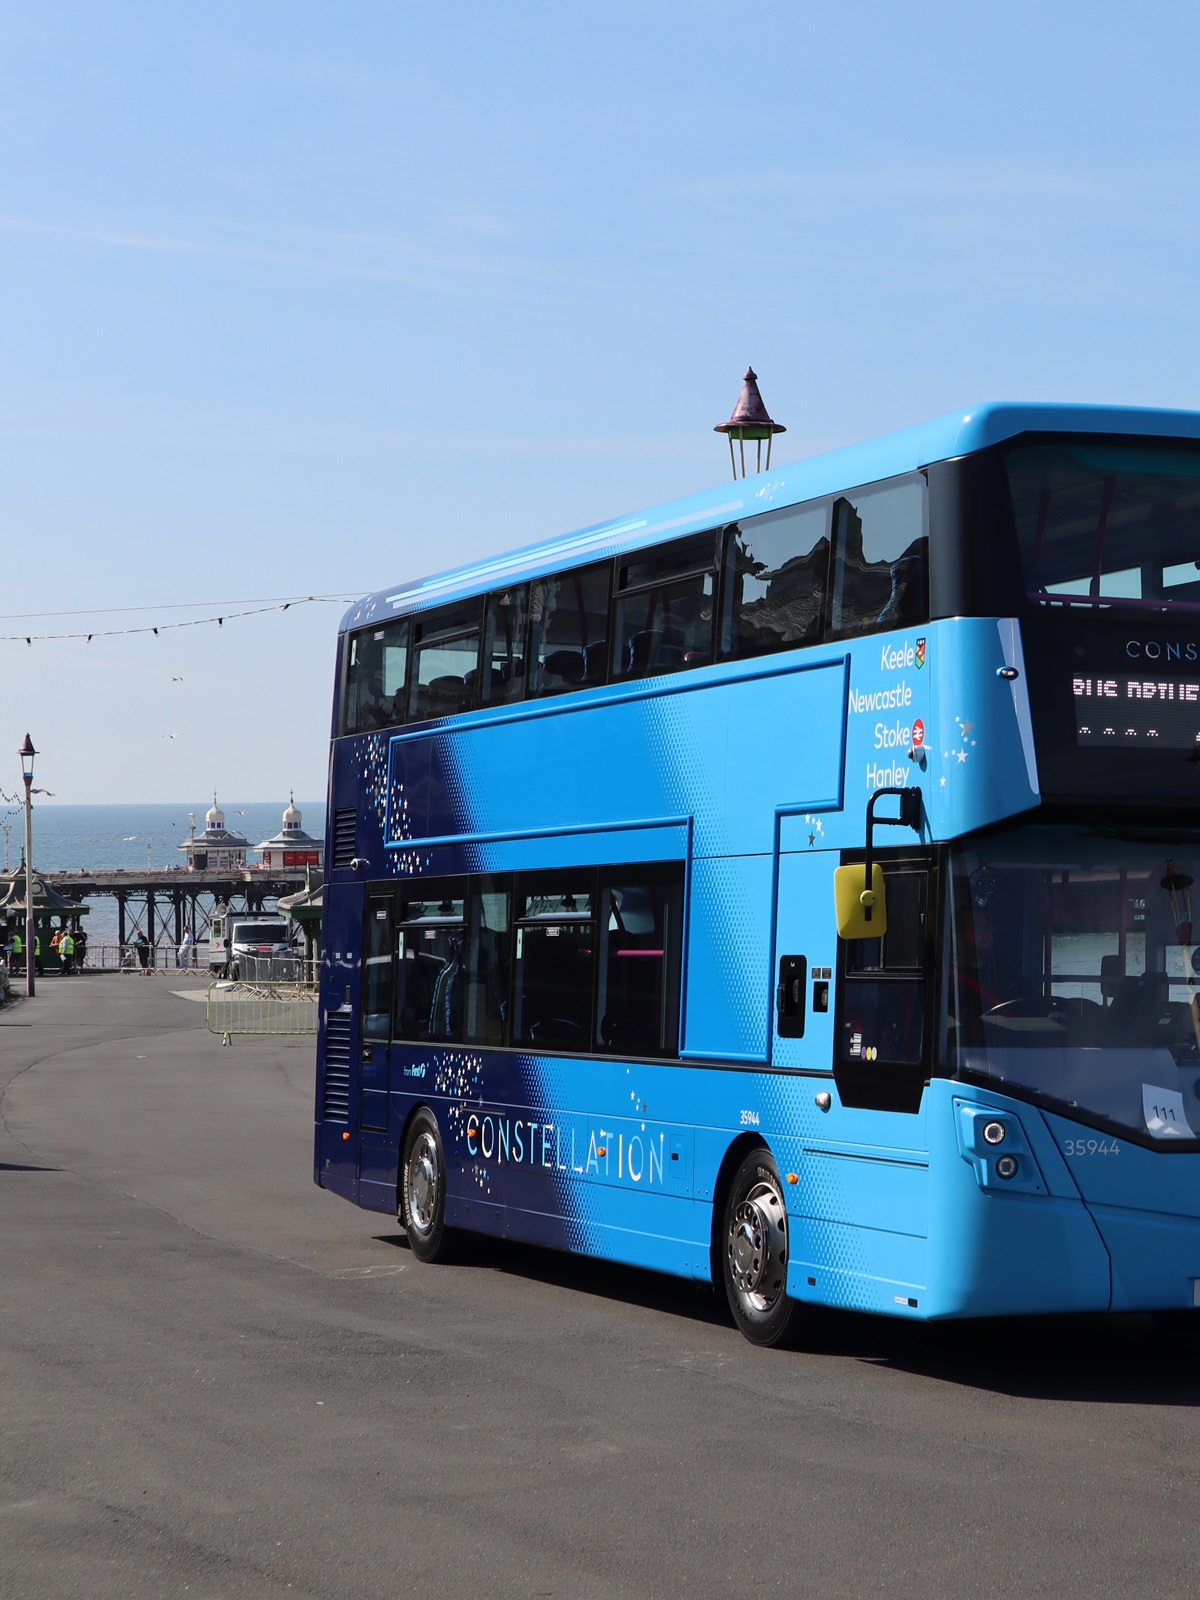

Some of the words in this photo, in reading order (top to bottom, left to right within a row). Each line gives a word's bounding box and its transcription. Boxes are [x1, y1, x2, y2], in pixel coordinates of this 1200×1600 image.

[880, 641, 914, 671] Keele
[848, 680, 912, 714] Newcastle
[874, 720, 910, 749] Stoke
[866, 760, 910, 788] Hanley
[740, 1110, 760, 1126] 35944
[1152, 1105, 1176, 1121] 111
[467, 1114, 666, 1186] CONSTELLATION
[1064, 1139, 1120, 1156] 35944
[403, 1162, 413, 1227] BRIDGESTONE
